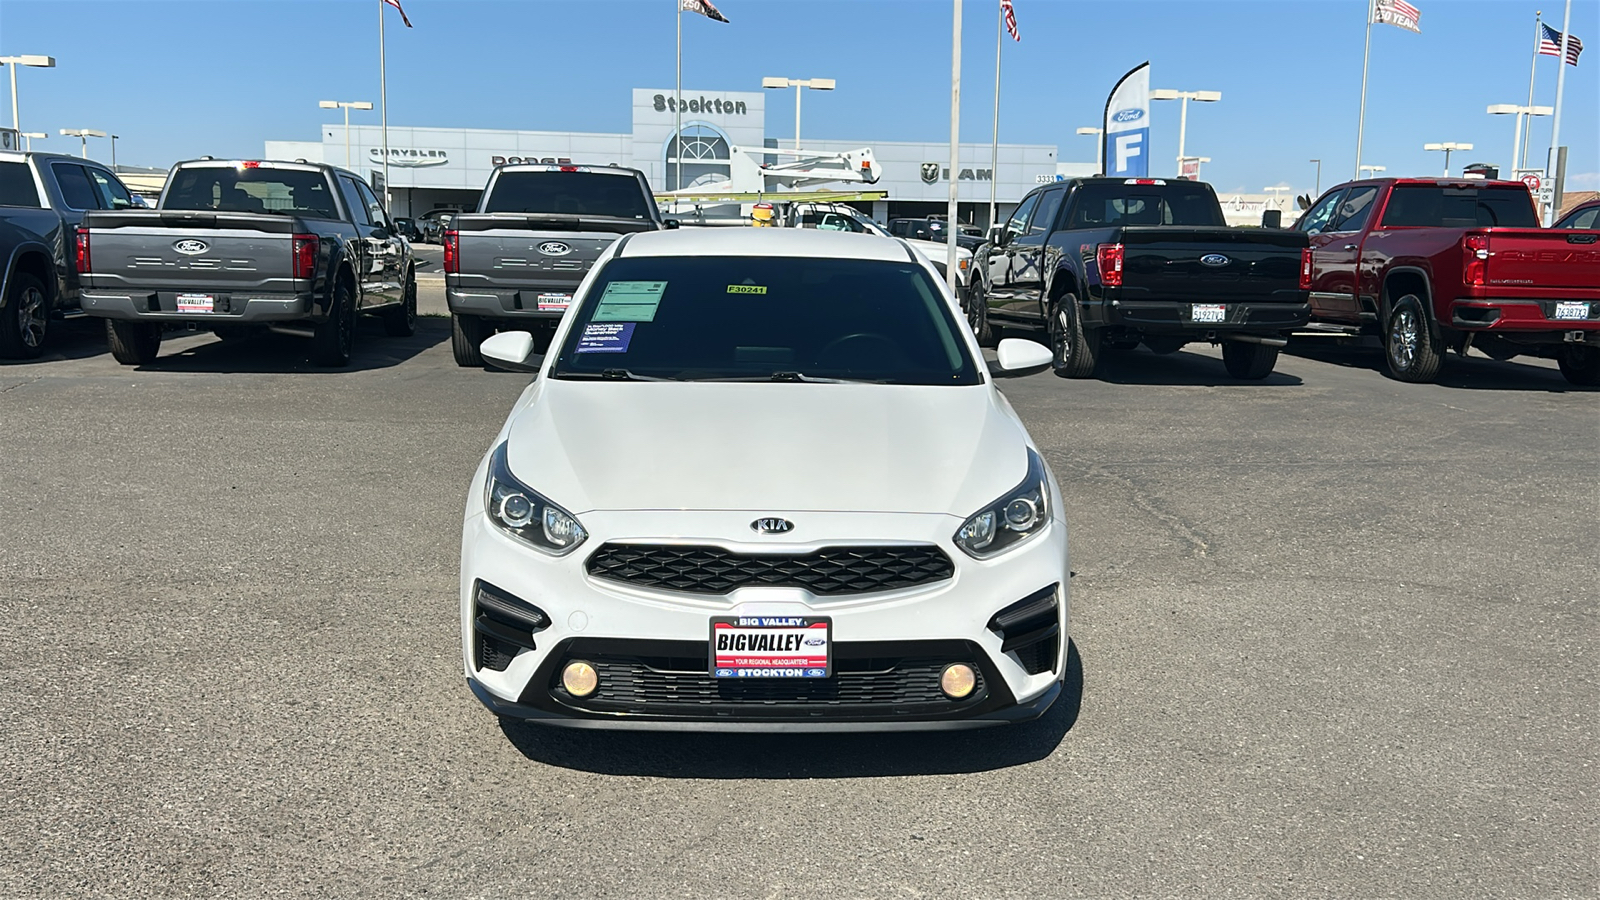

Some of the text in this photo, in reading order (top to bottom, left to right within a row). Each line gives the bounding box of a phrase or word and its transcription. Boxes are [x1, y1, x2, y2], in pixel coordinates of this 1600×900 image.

[653, 94, 747, 115] Stockton
[1117, 110, 1140, 121] Ford
[370, 149, 447, 157] CHRYSLER
[1116, 133, 1142, 172] F
[492, 156, 571, 164] DODGE
[181, 241, 202, 251] Ford
[545, 242, 564, 252] Ford
[758, 519, 788, 530] KIA
[739, 618, 802, 626] BIG VALLEY
[717, 634, 804, 651] BIGVALLEY
